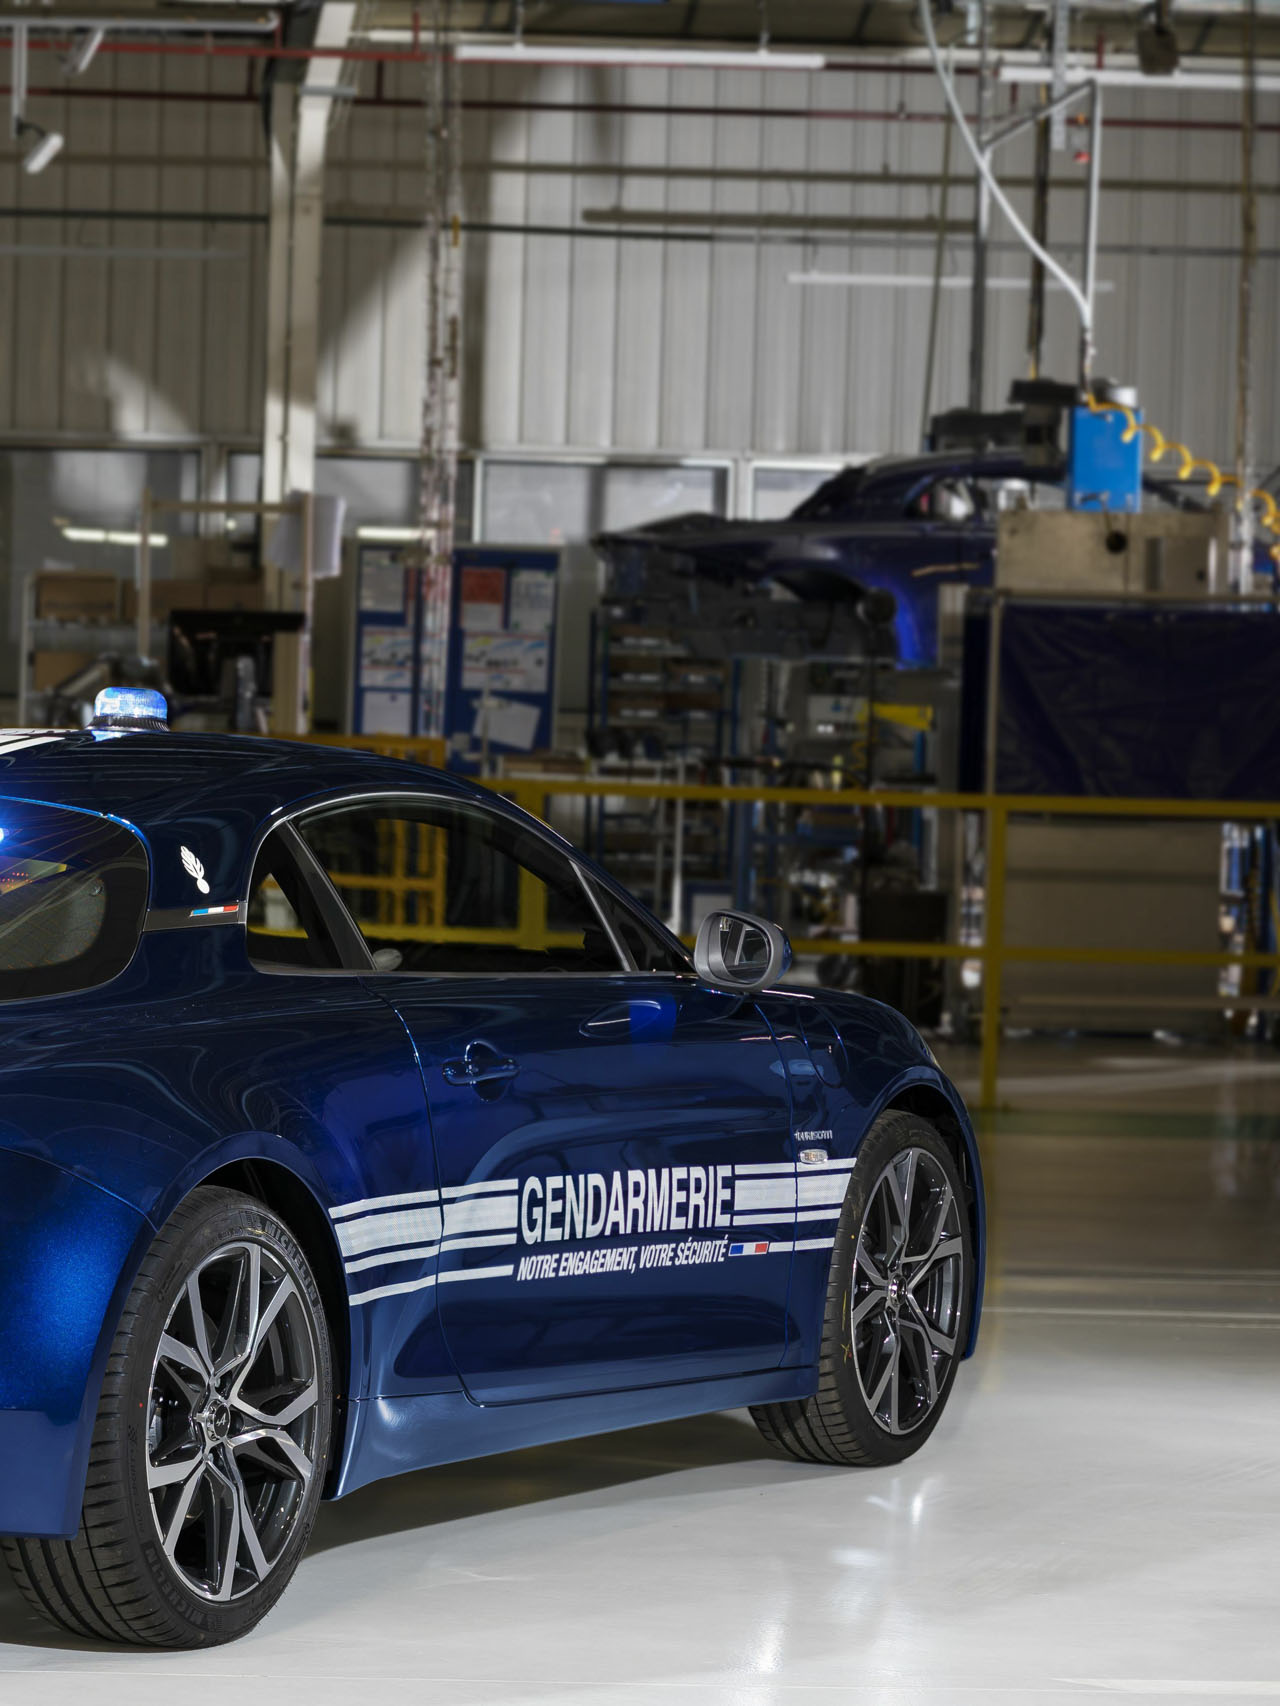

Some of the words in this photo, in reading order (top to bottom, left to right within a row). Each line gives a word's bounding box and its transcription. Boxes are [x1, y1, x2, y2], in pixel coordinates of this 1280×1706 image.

[522, 1165, 735, 1244] GENDARMERIE
[265, 1222, 319, 1300] MICHELIN
[516, 1253, 560, 1282] NOTRE
[558, 1245, 639, 1275] ENGAGEMENT,
[639, 1240, 675, 1269] VOTRE
[674, 1233, 729, 1266] SÉCURITÉ
[144, 1547, 206, 1625] MICHELIN
